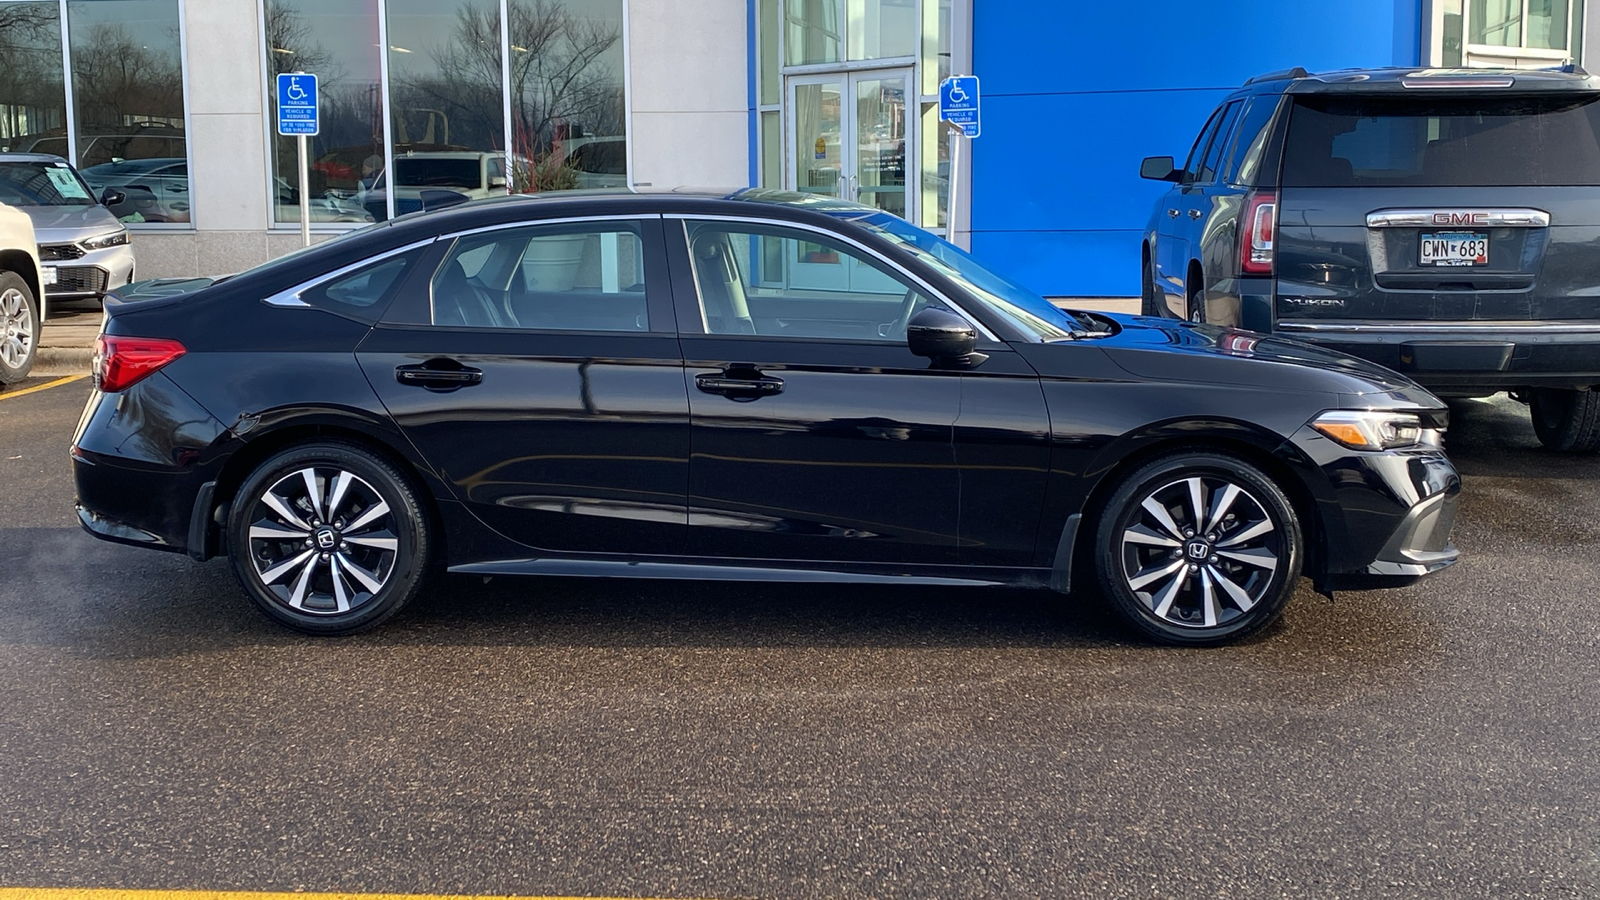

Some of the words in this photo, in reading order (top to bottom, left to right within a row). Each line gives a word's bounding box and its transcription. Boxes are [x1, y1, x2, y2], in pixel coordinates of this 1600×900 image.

[1432, 212, 1490, 225] GMC
[1423, 240, 1449, 257] CWN
[1459, 240, 1485, 257] 683
[1284, 298, 1345, 307] YUKON
